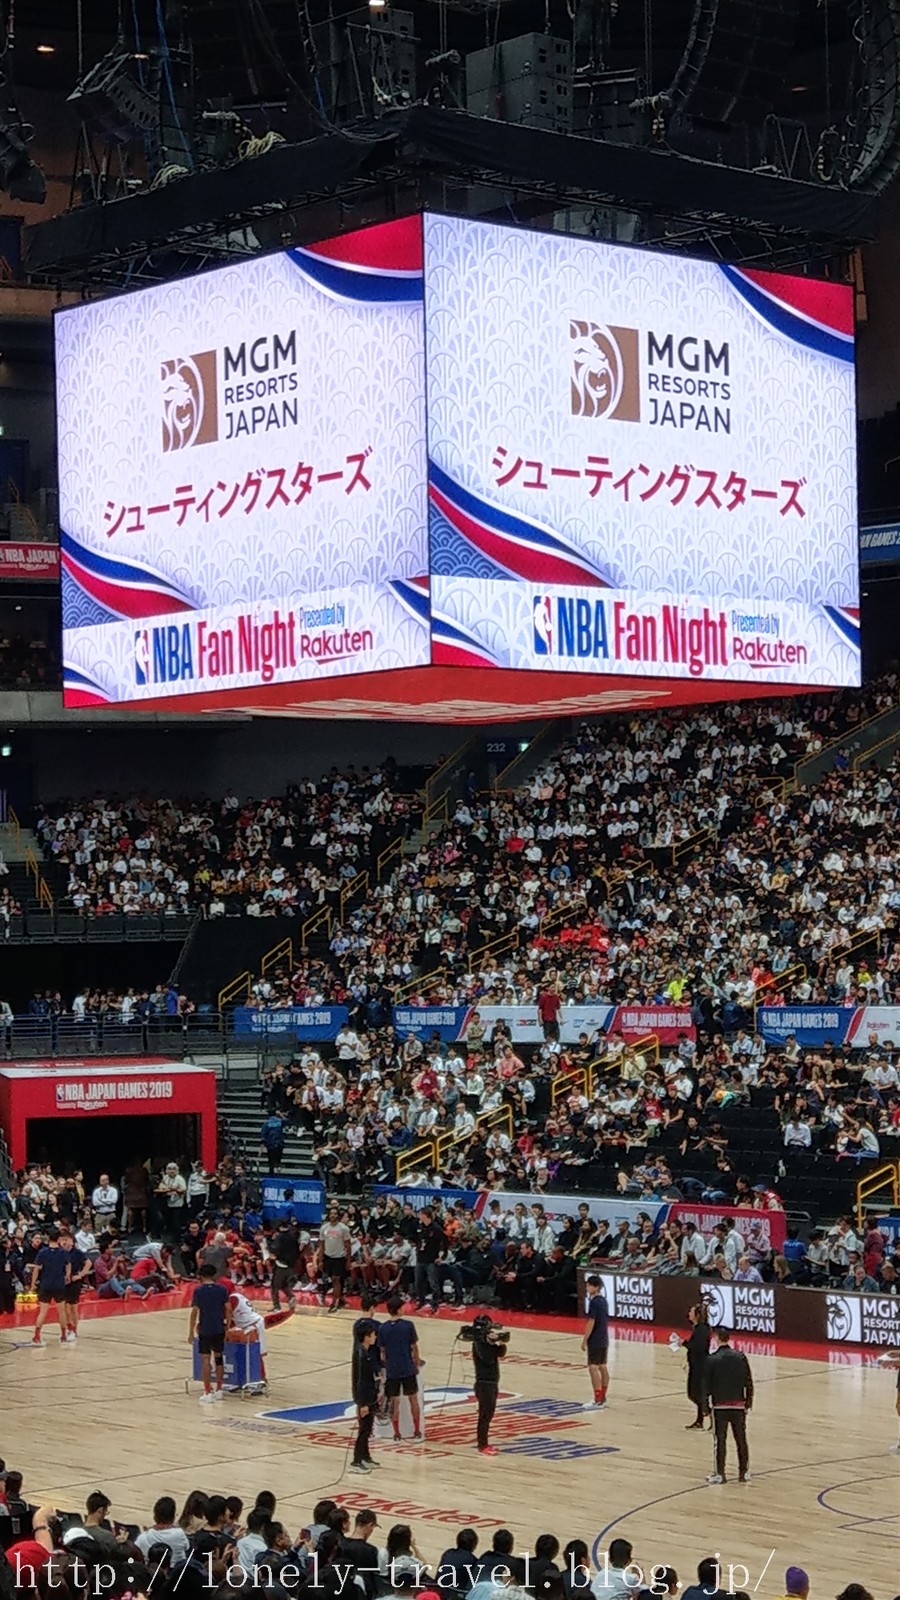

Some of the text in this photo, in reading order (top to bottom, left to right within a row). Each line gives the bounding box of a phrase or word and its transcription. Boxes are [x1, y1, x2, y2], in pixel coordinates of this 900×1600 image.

[224, 330, 296, 381] MGM
[648, 331, 729, 377] MGM
[224, 372, 298, 405] RESORTS
[648, 373, 730, 400] RESORTS
[225, 398, 298, 439] JAPAN
[649, 398, 730, 434] JAPAN
[103, 445, 373, 538] シューティングスターズ
[492, 446, 807, 518] シューティングスターズ
[153, 611, 296, 683] NBA Fan Night
[301, 630, 373, 658] Rakuten
[557, 597, 728, 676] NBA Fan Night
[733, 637, 807, 664] Rakuten
[486, 742, 506, 752] 232
[65, 1081, 173, 1101] NBA JAPAN GAMES 2019
[616, 1276, 653, 1295] MGM
[616, 1293, 653, 1306] RESORTS
[735, 1287, 774, 1307] MGM
[616, 1304, 654, 1320] JAPAN
[735, 1305, 775, 1318] RESORTS
[735, 1316, 775, 1333] JAPAN
[322, 1492, 507, 1528] Rakuten
